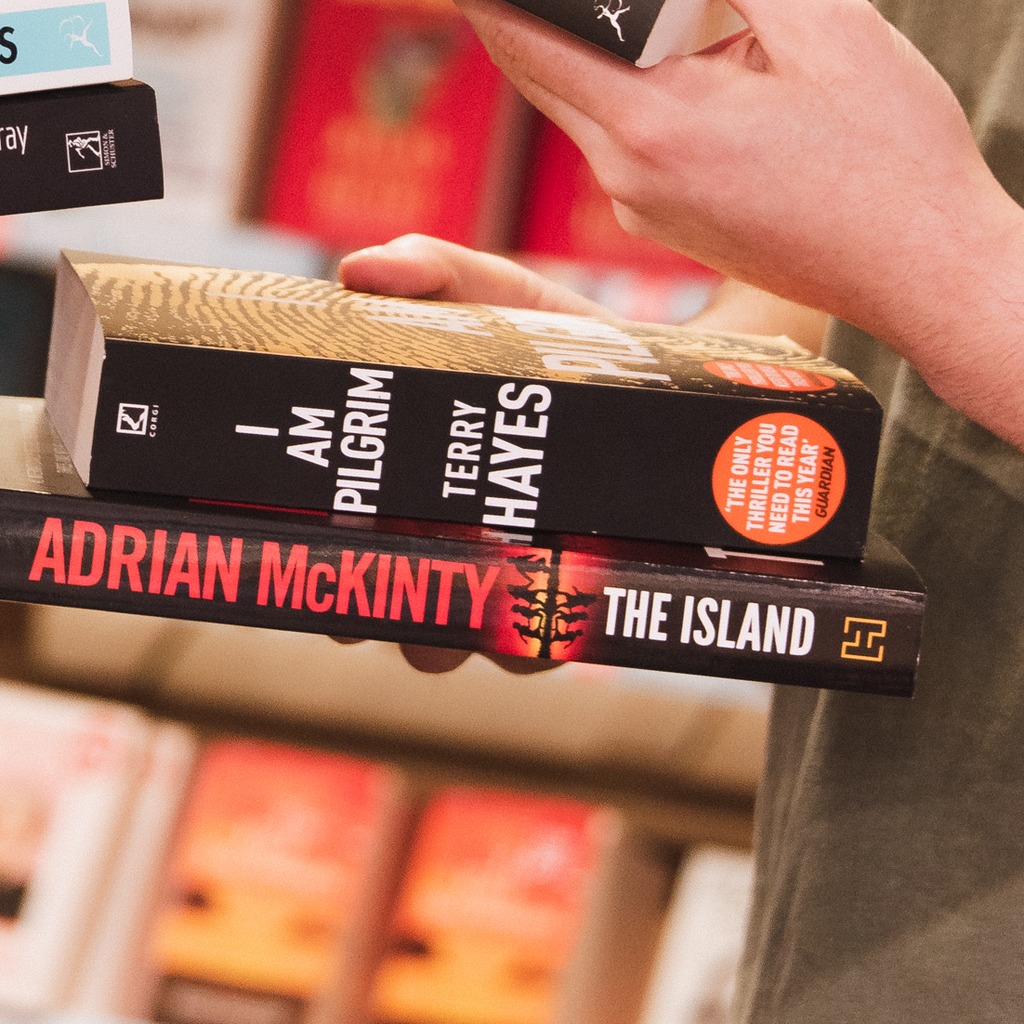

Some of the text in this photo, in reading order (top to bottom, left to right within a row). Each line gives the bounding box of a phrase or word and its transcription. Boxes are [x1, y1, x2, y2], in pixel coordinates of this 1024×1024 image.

[102, 140, 111, 166] SIMON
[108, 129, 117, 169] SCHUSTER
[149, 404, 160, 438] CORGI
[234, 424, 280, 437] I
[286, 406, 336, 468] AM
[332, 367, 394, 514] PILGRIM
[442, 399, 487, 499] TERRY
[482, 382, 553, 528] HAYES
[730, 436, 753, 475] ONLY
[746, 423, 777, 531] THRILLER YOU
[768, 424, 799, 534] NEED TO READ
[815, 446, 836, 518] GUARDIAN
[791, 487, 814, 523] THIS
[28, 517, 816, 657] ADRIAN McKINTY THE ISLAND
